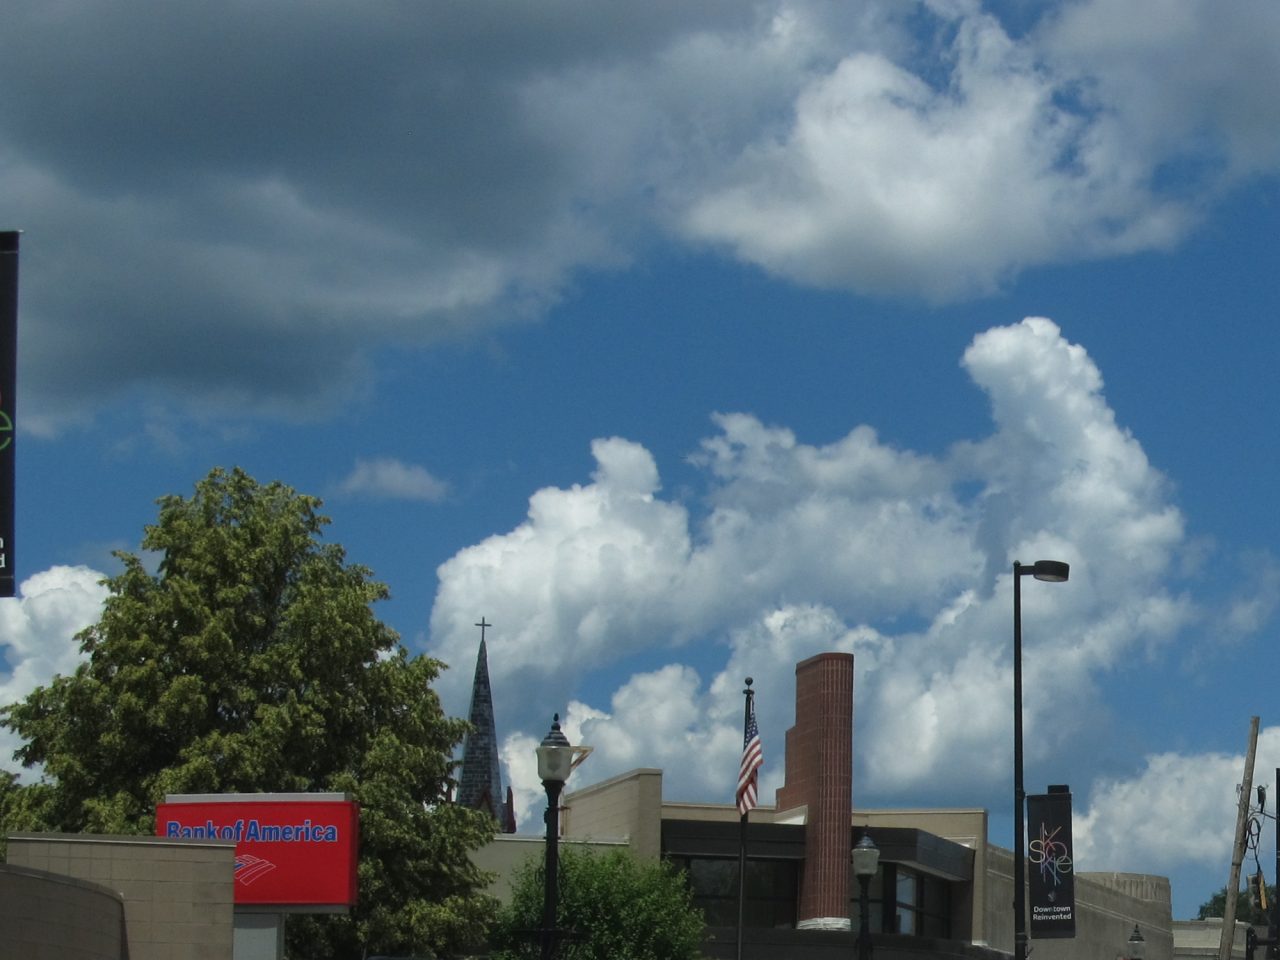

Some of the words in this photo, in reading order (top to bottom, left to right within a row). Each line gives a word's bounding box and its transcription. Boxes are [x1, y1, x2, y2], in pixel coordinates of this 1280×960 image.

[166, 820, 221, 840] Bank
[221, 820, 244, 842] of
[245, 820, 338, 842] America
[1032, 913, 1072, 921] Reinvented
